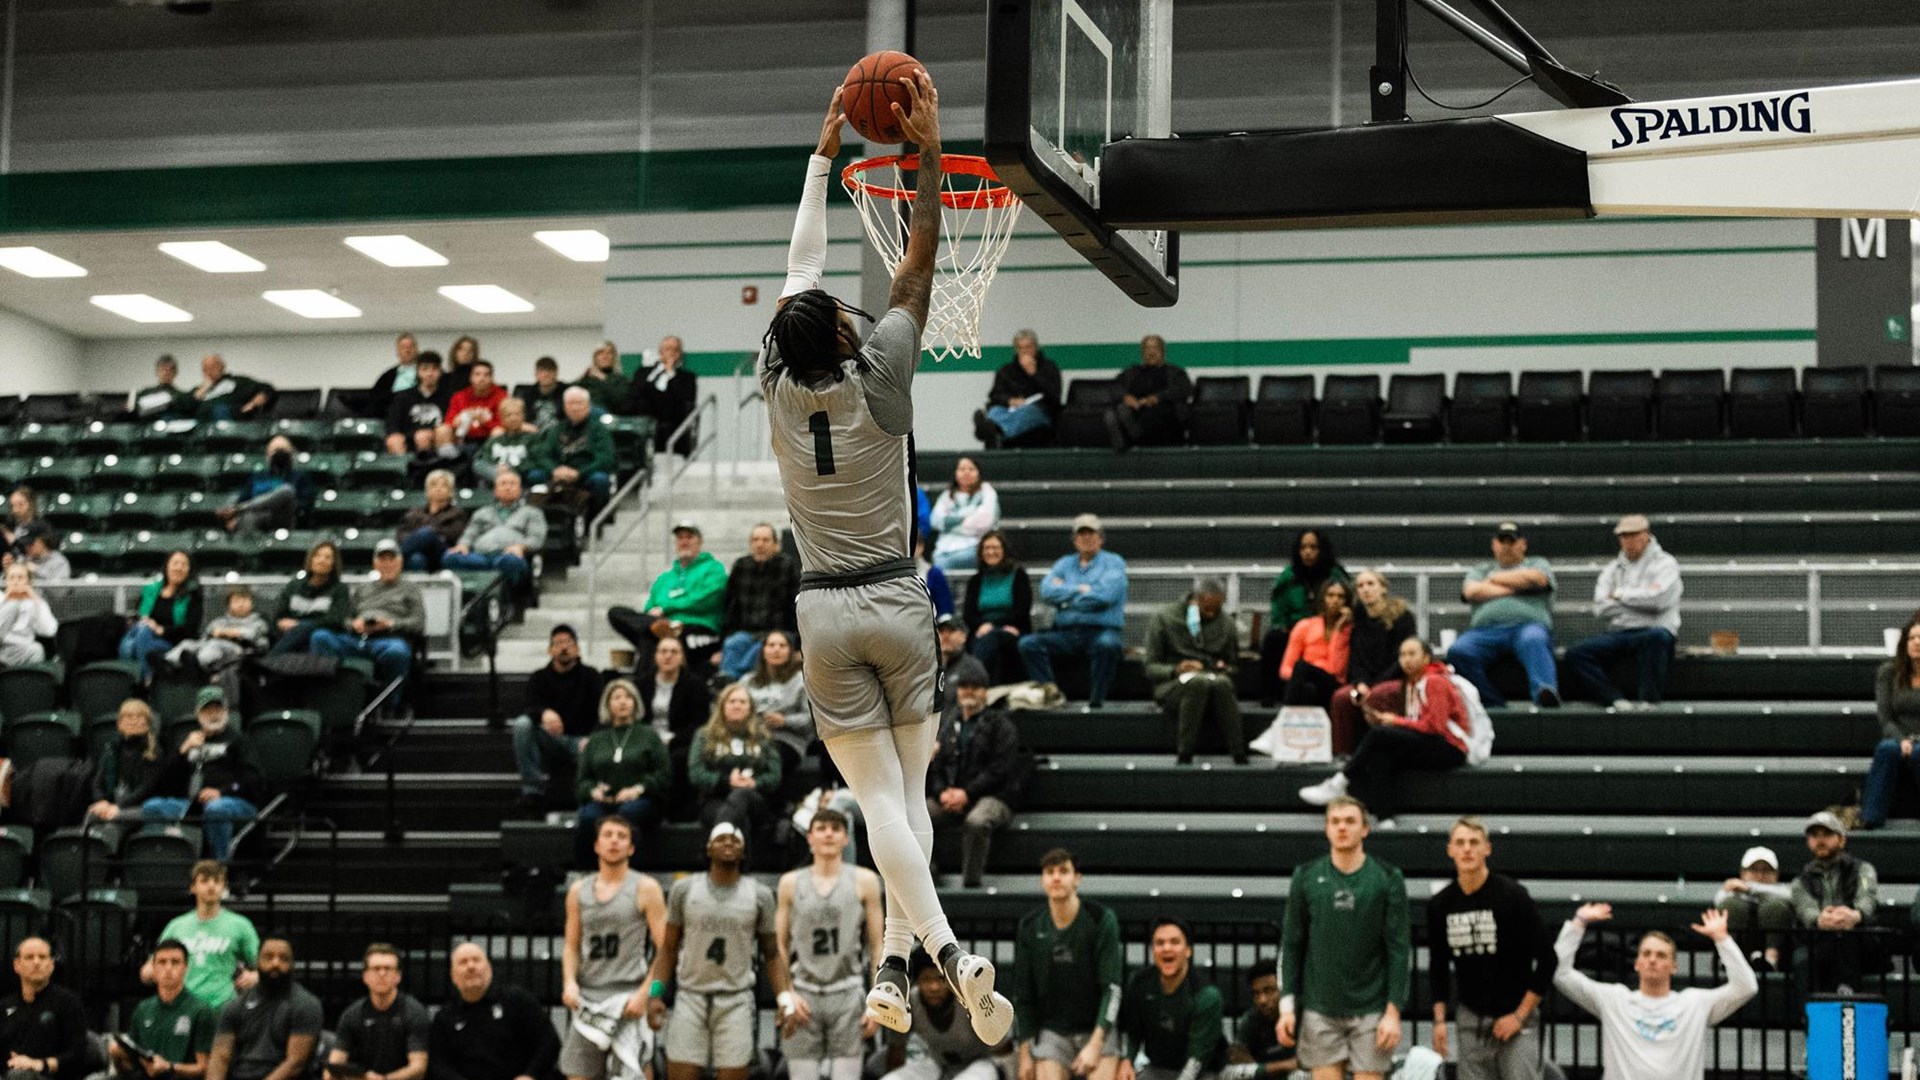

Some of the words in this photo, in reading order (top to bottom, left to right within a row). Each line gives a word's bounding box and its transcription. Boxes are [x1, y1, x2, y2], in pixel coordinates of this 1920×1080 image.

[1611, 92, 1811, 149] SPALDING
[1841, 218, 1887, 259] M
[808, 411, 836, 476] 1
[588, 933, 620, 960] 20
[706, 936, 727, 966] 4
[812, 927, 840, 955] 21
